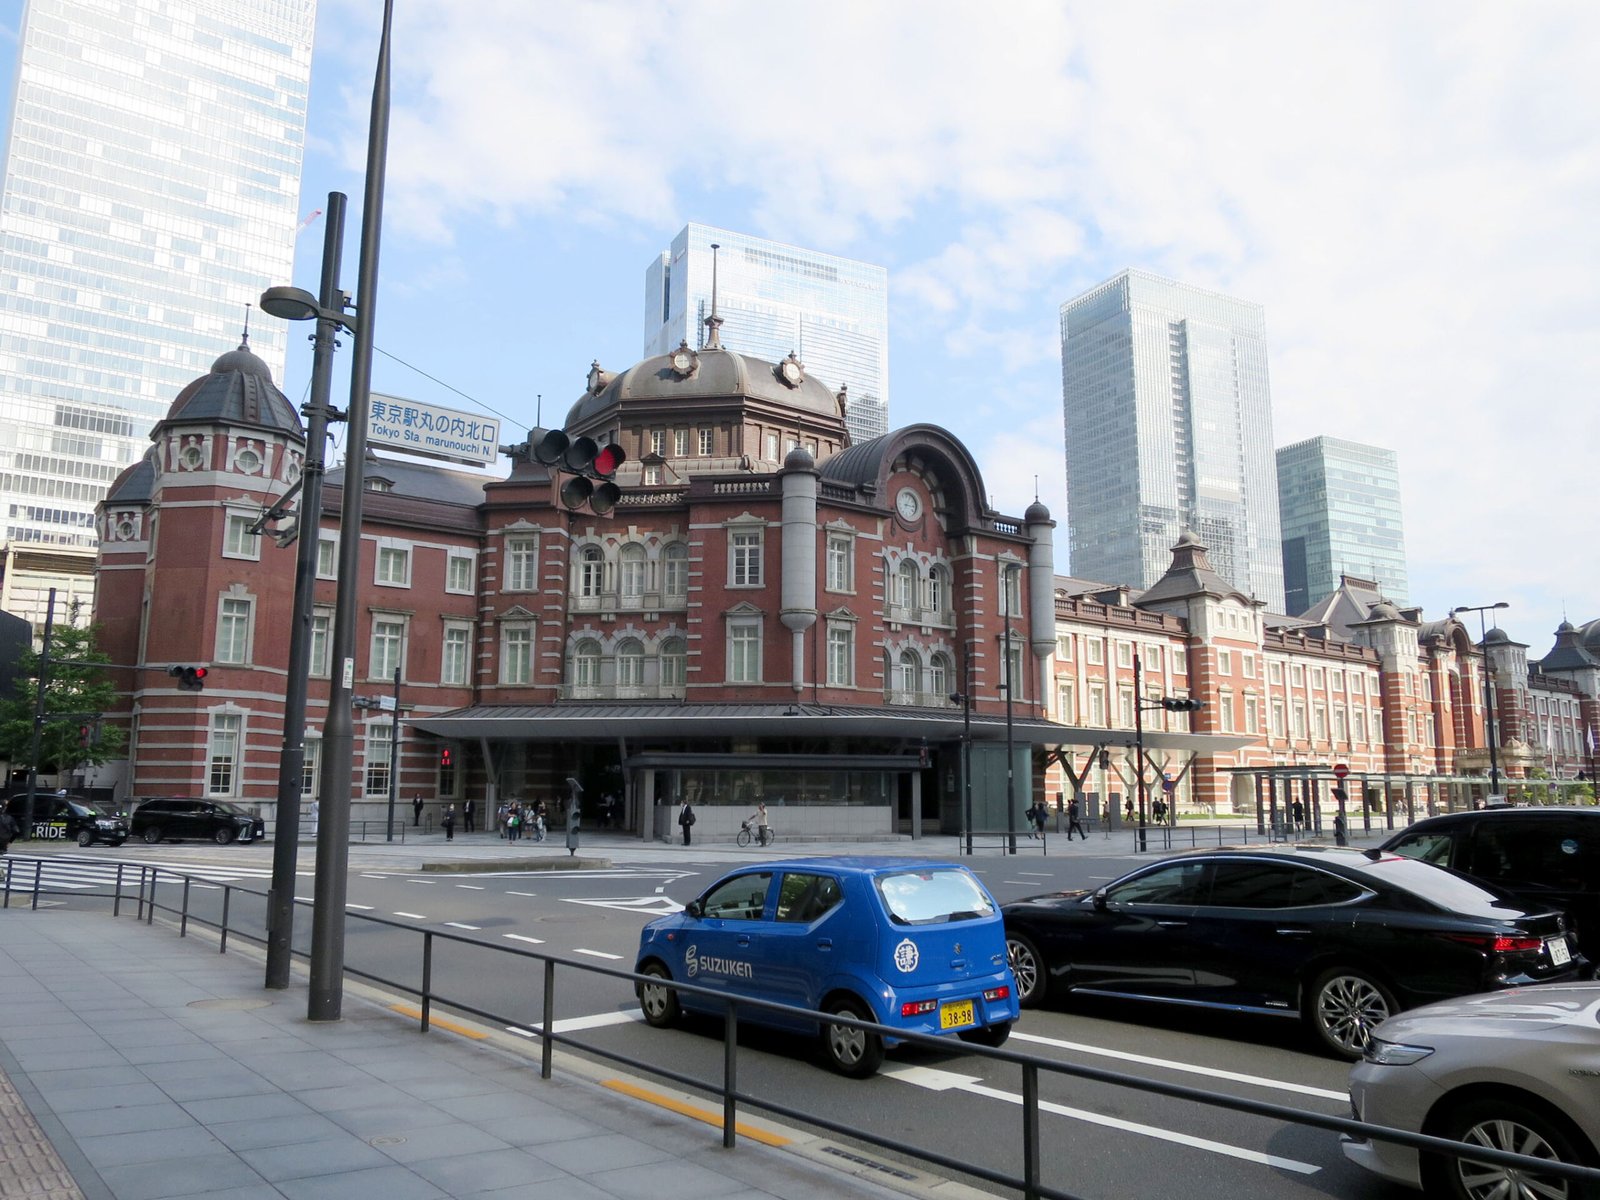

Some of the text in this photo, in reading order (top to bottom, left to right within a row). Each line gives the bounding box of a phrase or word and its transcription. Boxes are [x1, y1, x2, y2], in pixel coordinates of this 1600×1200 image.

[370, 401, 495, 443] 東京駅丸の内北口
[371, 423, 400, 439] Tokyo
[404, 429, 422, 443] Sta.
[426, 436, 480, 454] marunouchi
[31, 826, 67, 839] .RIDE
[948, 1010, 972, 1026] 38-98
